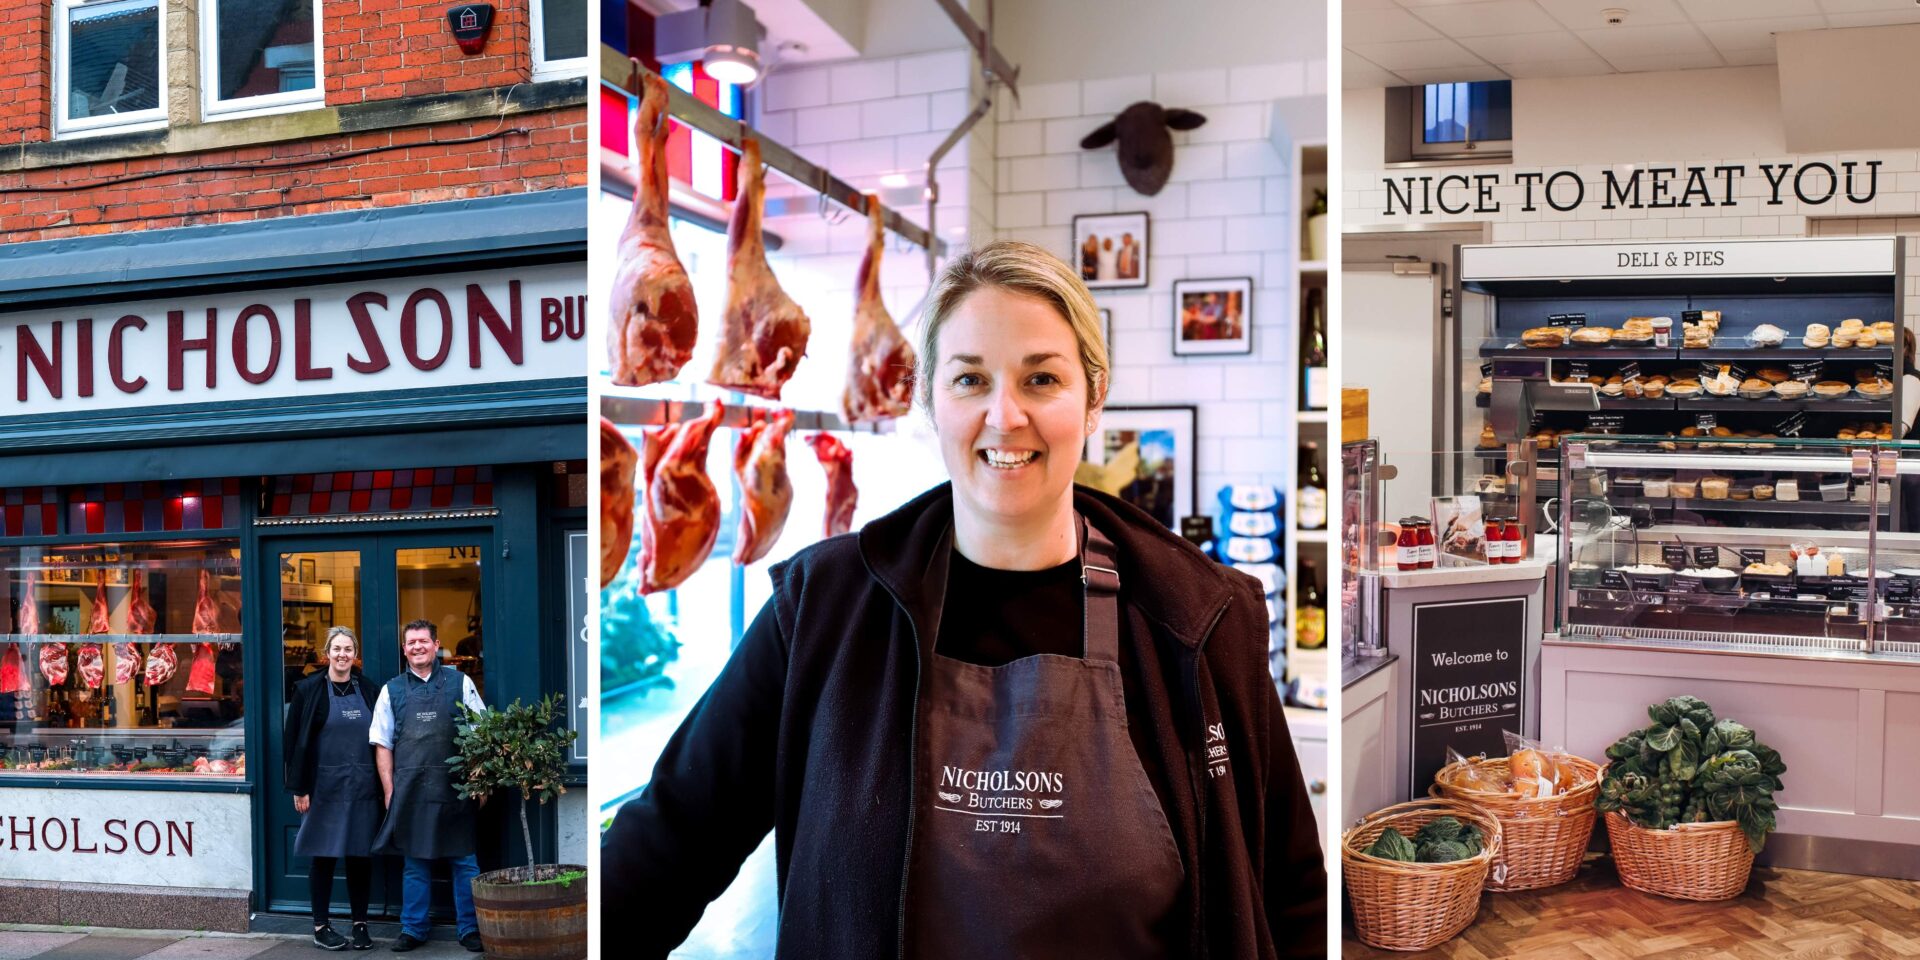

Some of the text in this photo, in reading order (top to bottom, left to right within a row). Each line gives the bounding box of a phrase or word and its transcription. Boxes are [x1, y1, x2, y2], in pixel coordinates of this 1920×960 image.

[1382, 160, 1883, 216] NICE TO MEAT YOU
[1617, 250, 1724, 269] DELI & PIES
[16, 280, 588, 402] NICHOLSON BU
[1431, 649, 1509, 667] Welcome to
[1420, 681, 1517, 707] NICHOLSONS
[1439, 703, 1498, 720] BUTCHERS
[1469, 723, 1482, 731] 1914
[940, 765, 1063, 793] NICHOLSONS
[968, 792, 1033, 810] BUTCHERS
[975, 820, 1021, 833] EST 1914
